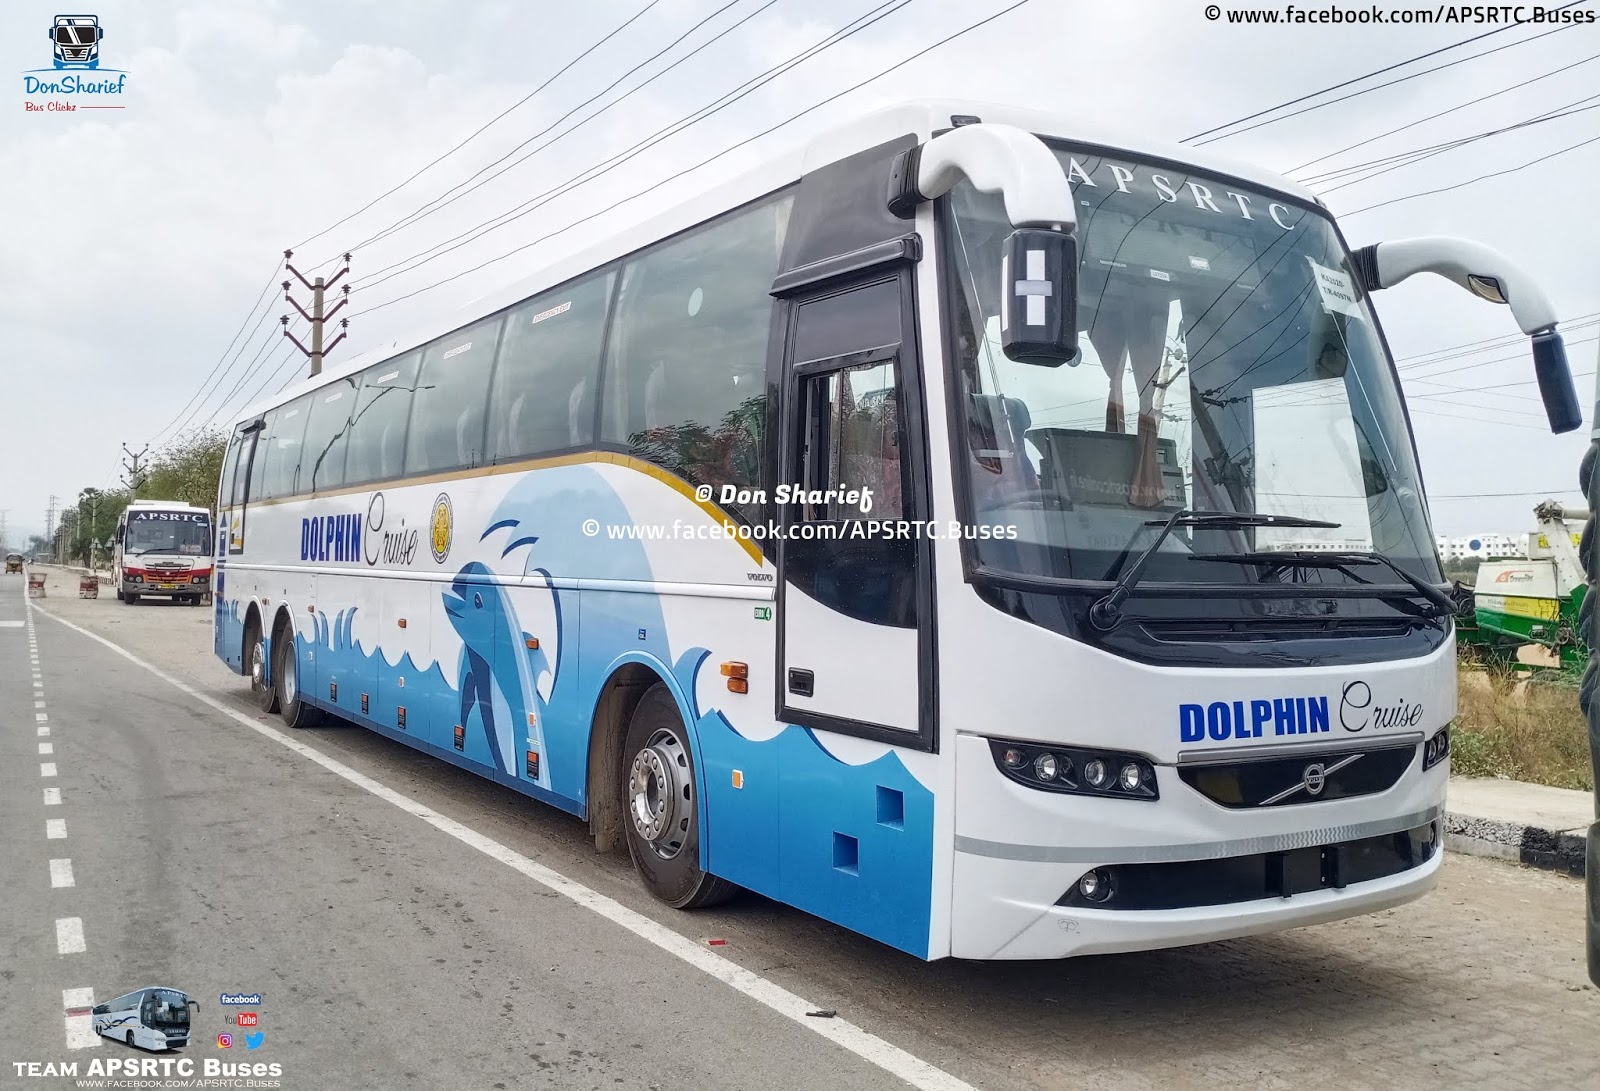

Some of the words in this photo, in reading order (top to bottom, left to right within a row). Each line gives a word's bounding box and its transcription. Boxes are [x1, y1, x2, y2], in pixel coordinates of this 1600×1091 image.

[1066, 156, 1295, 231] APSRTC
[136, 513, 203, 522] APSRTC
[301, 513, 362, 562] DOLPHIN
[364, 491, 419, 566] Cruise
[747, 573, 773, 582] VOLVO
[1179, 696, 1330, 742] DOLPHIN
[1338, 680, 1424, 732] Cruise
